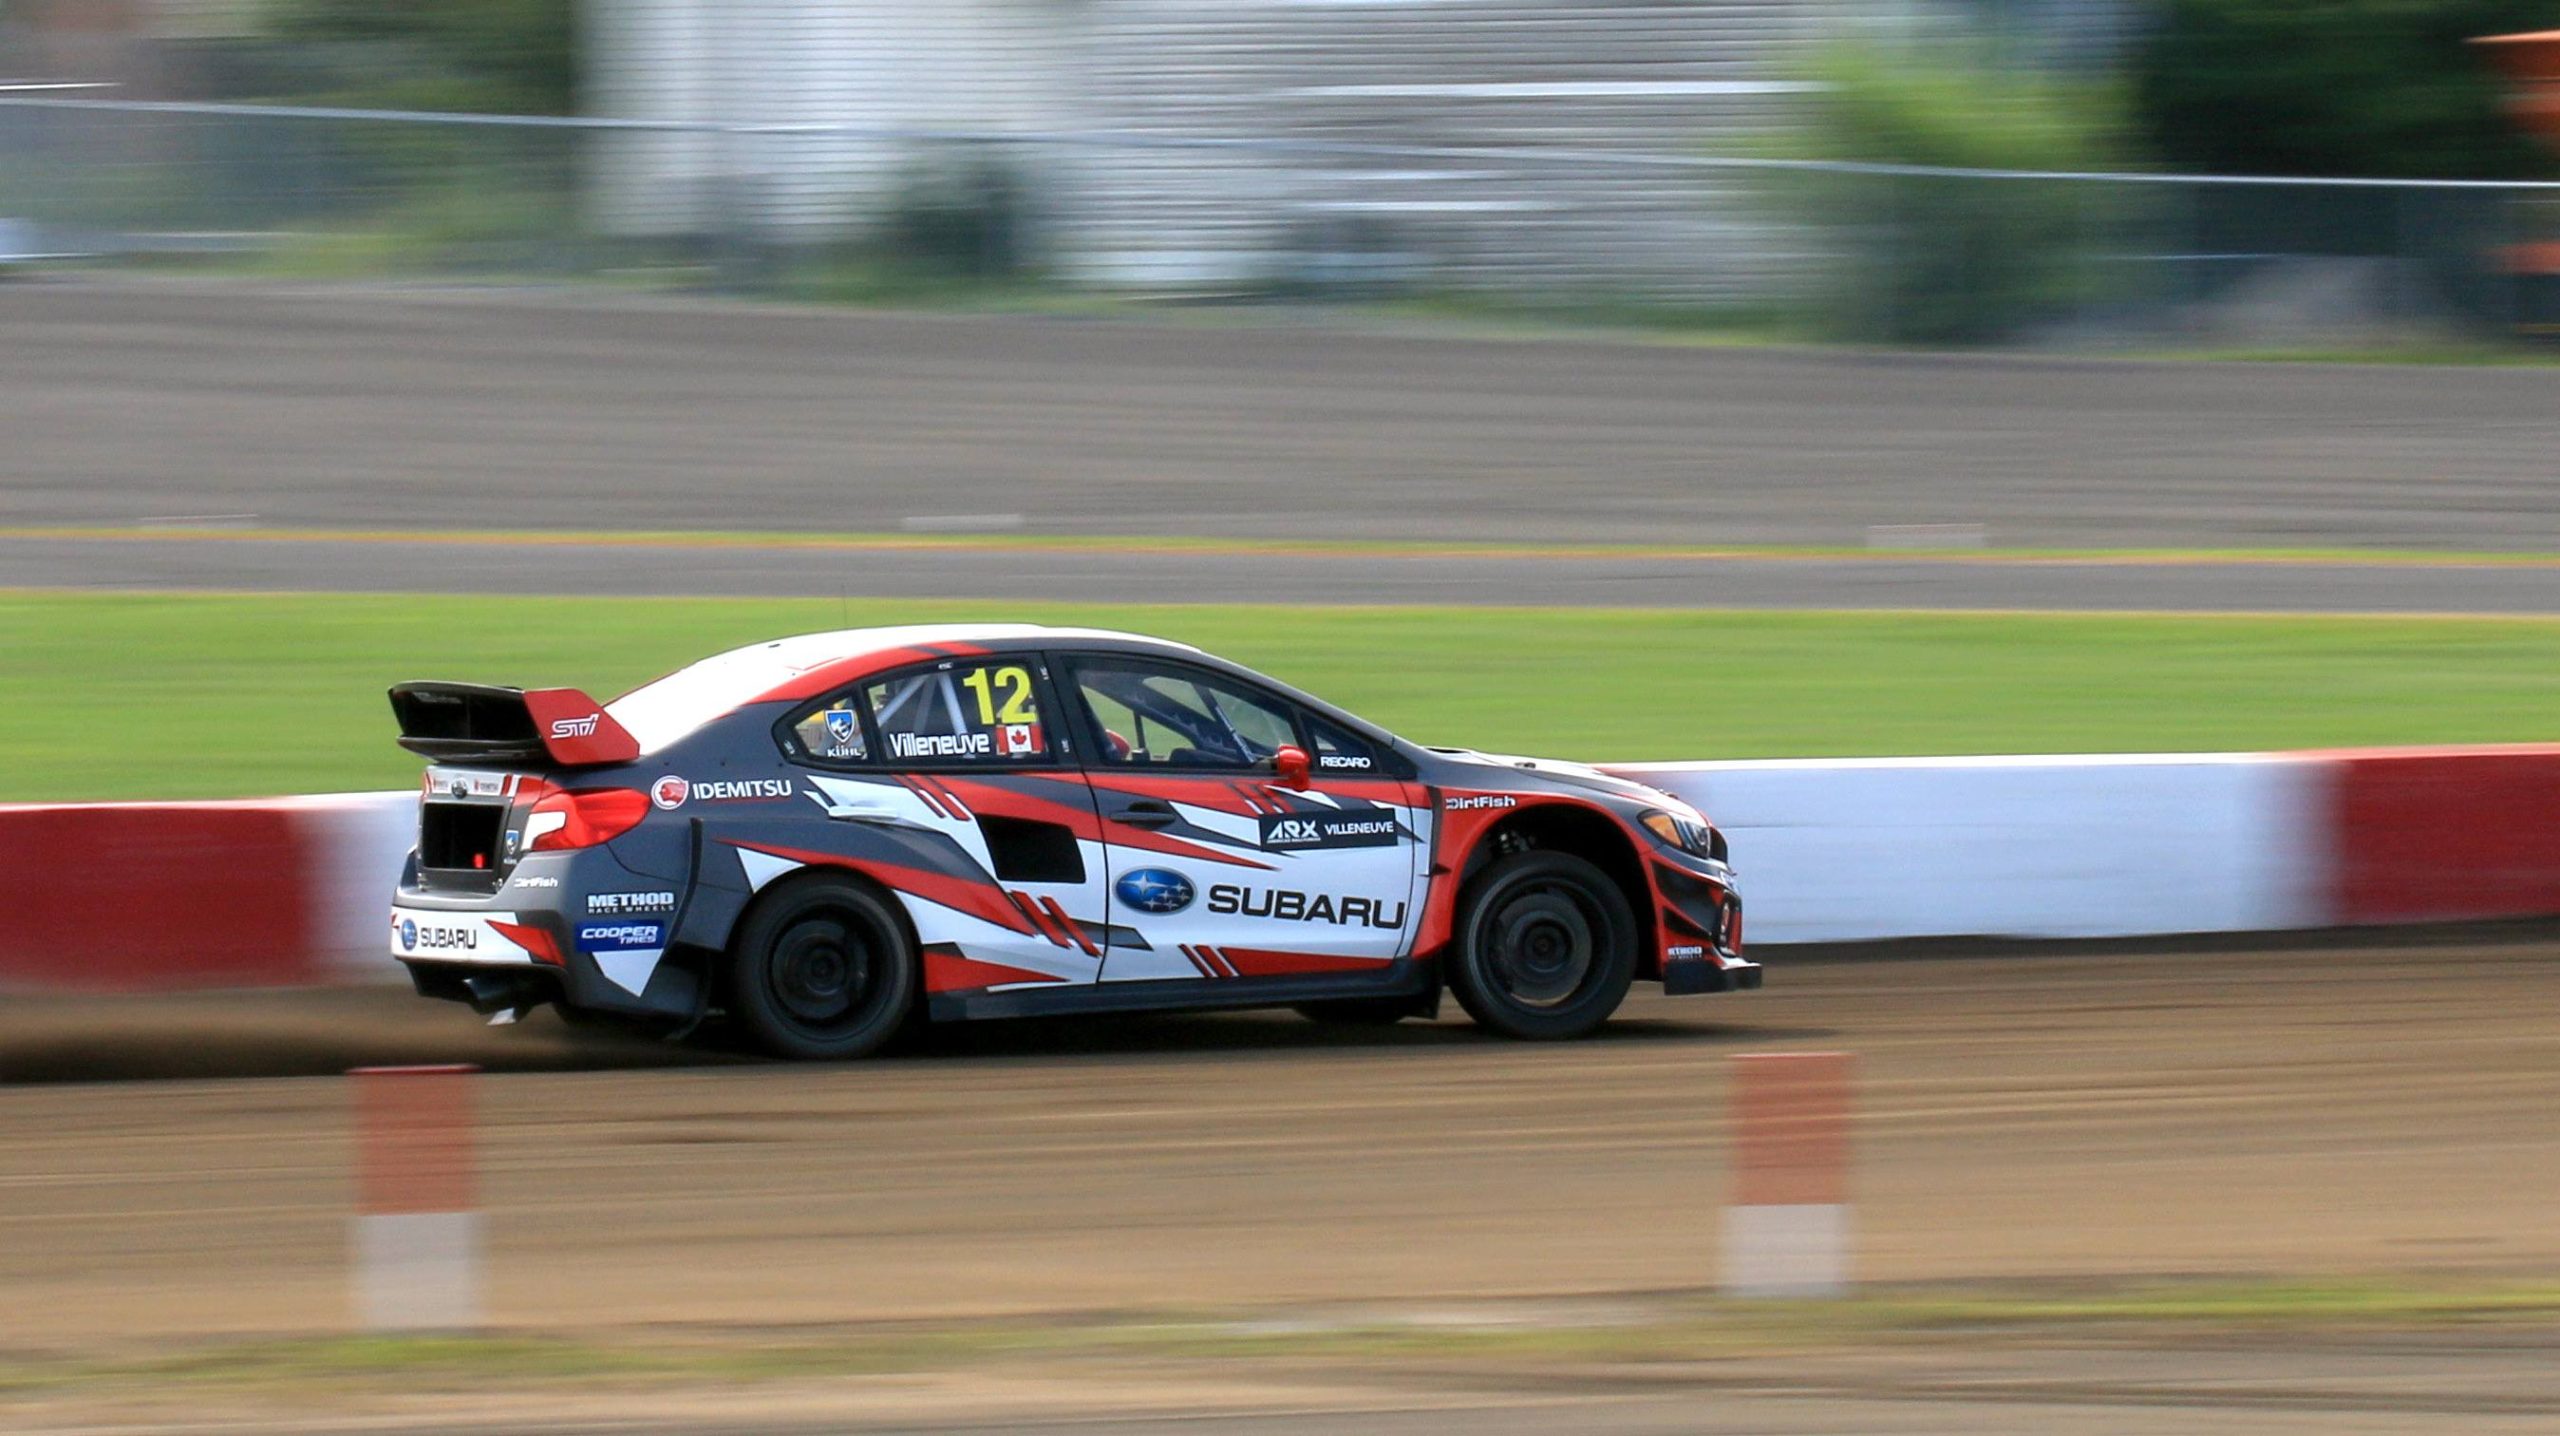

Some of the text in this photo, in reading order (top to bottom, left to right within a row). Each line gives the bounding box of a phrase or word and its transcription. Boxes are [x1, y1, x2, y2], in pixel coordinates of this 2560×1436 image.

[963, 667, 1038, 724] 12
[889, 732, 990, 757] Villeneuve
[1320, 756, 1371, 768] RECARO
[692, 779, 792, 800] IDEMITSU
[1267, 820, 1395, 840] ARX VILLENEUVE
[587, 892, 675, 908] METHOD
[625, 904, 675, 912] WHEELS
[1207, 883, 1405, 930] SUBARU
[421, 927, 477, 950] SUBARU
[581, 925, 658, 939] COOPER
[620, 936, 657, 944] TIRES
